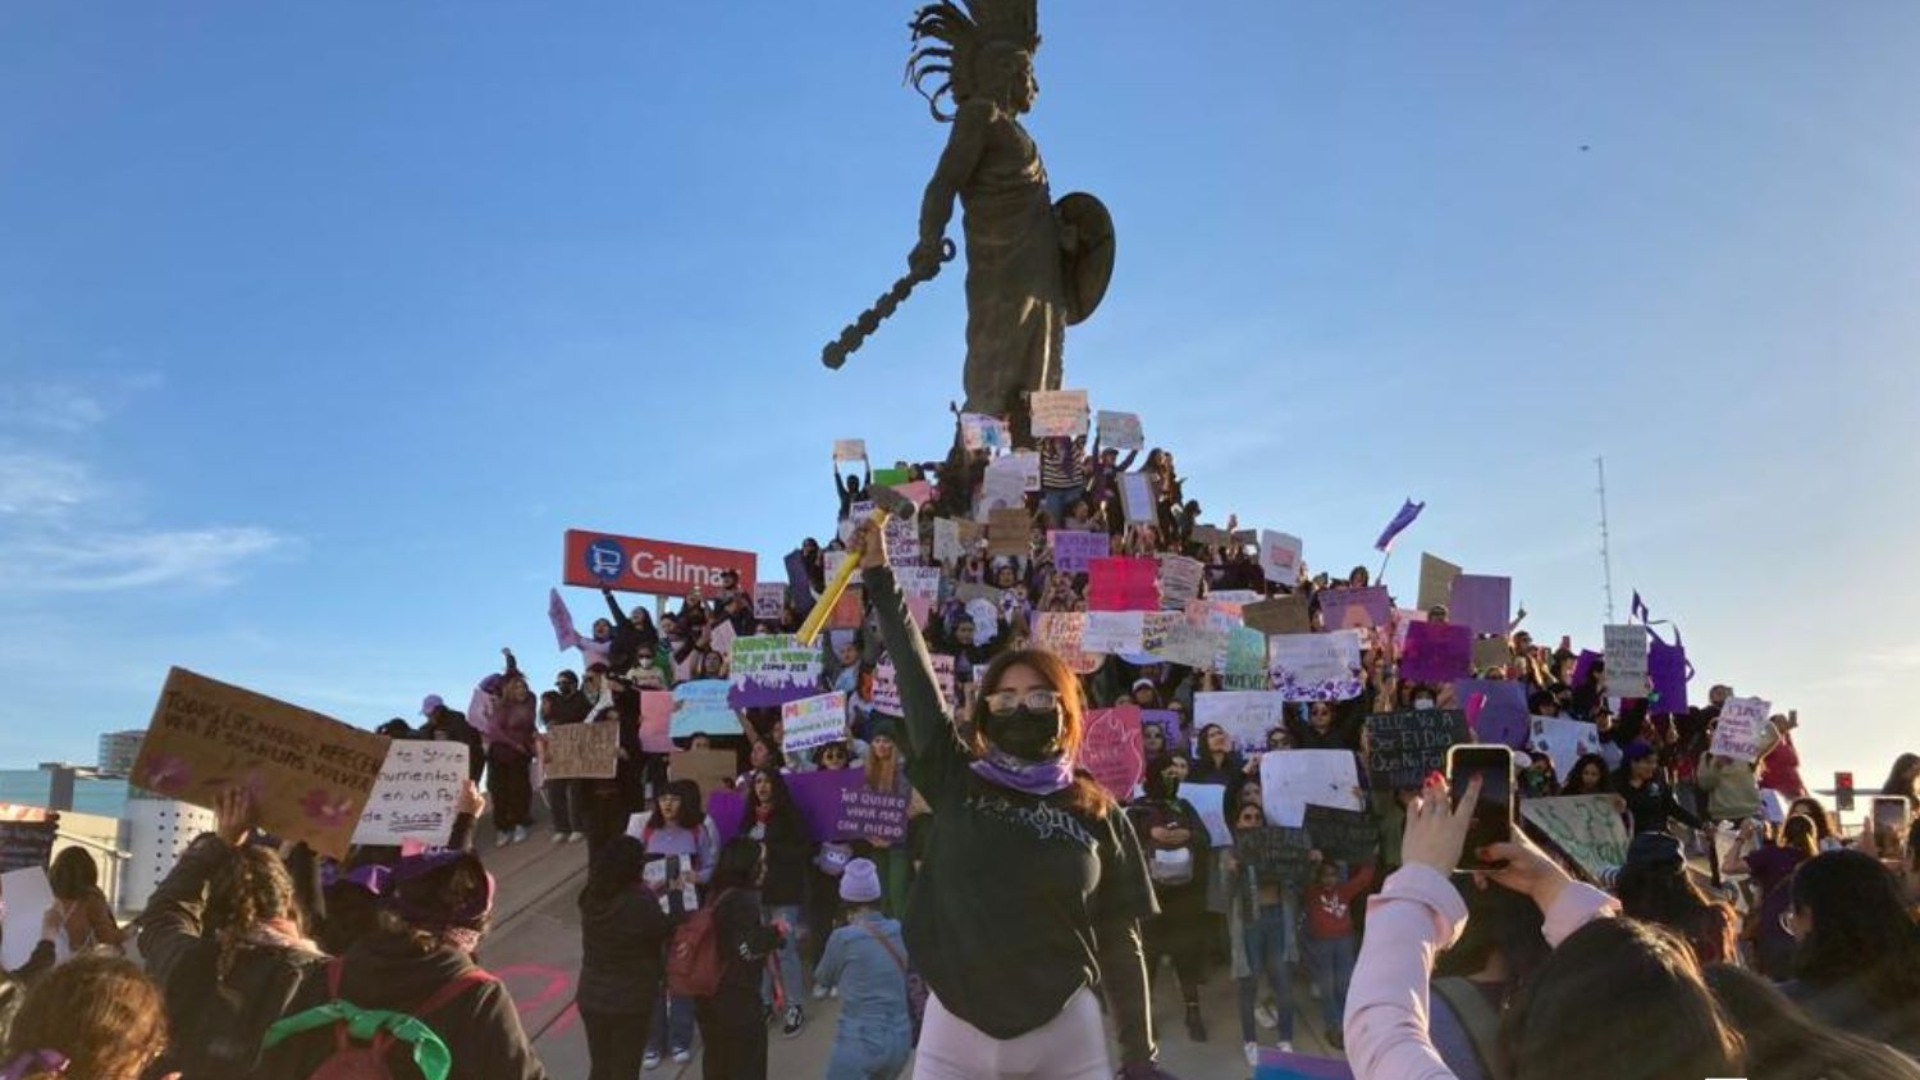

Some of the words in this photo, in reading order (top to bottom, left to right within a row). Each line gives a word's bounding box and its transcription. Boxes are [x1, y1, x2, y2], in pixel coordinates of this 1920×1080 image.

[383, 790, 404, 801] en
[411, 790, 430, 801] un
[362, 811, 382, 824] de
